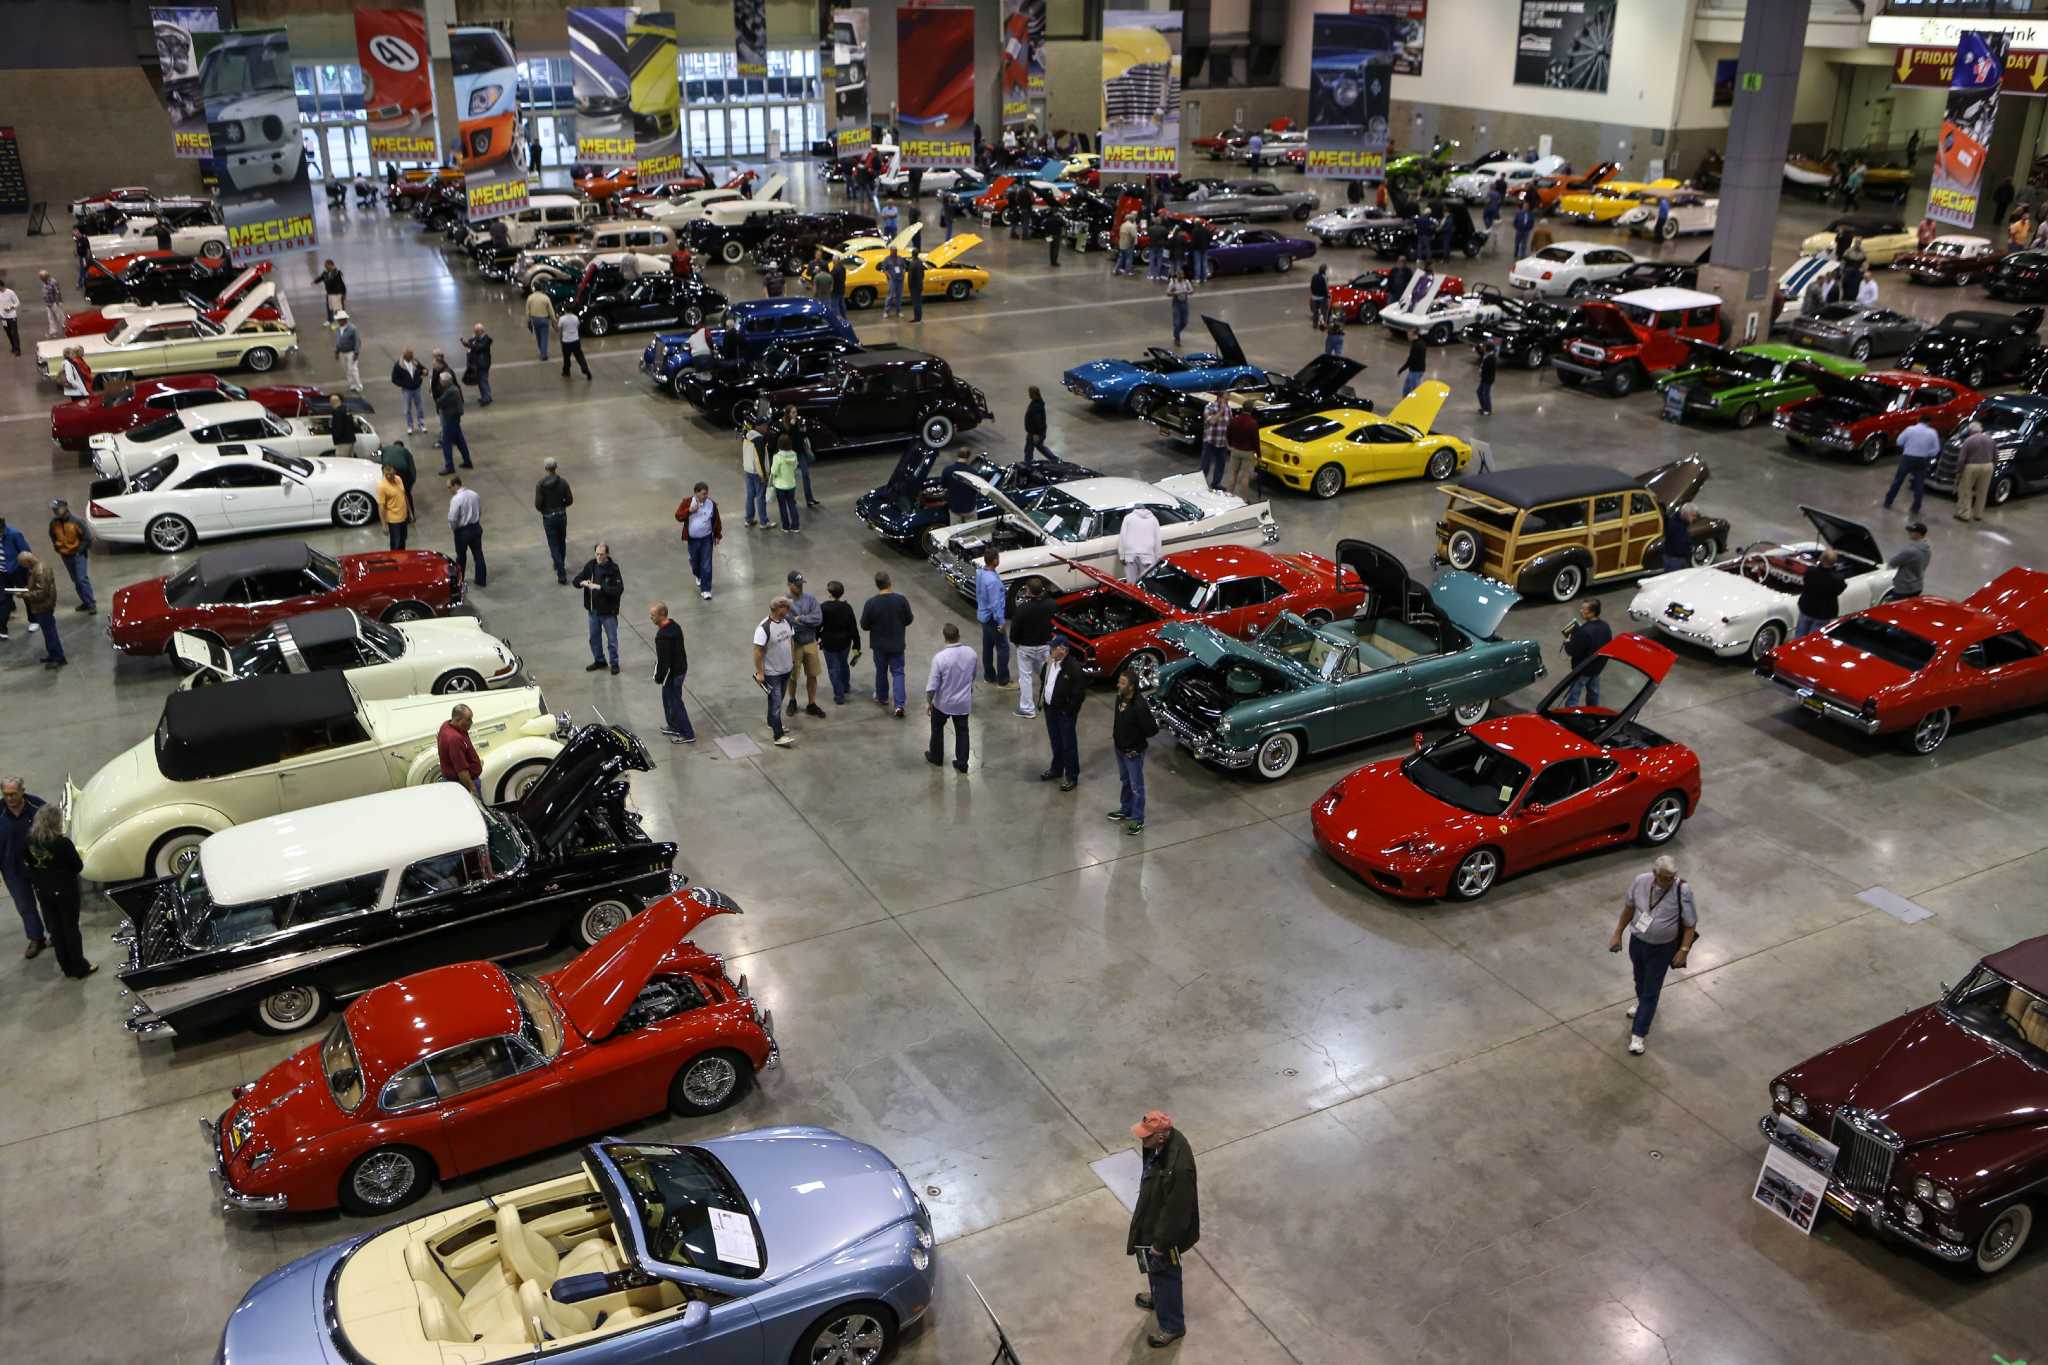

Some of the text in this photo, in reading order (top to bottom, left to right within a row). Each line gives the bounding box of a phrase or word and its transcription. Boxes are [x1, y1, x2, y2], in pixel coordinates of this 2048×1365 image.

[375, 37, 415, 66] 41
[1914, 51, 1957, 65] FRIDAY
[175, 132, 210, 148] MEC
[371, 137, 435, 152] MECUM
[838, 128, 872, 145] MECUM
[901, 141, 972, 157] MECUM
[1104, 145, 1176, 161] MECUM
[638, 155, 681, 177] MECUM
[1308, 151, 1383, 168] MECUM
[470, 181, 526, 207] MECUM
[1930, 188, 1976, 213] MECUM
[229, 215, 314, 248] MECUM
